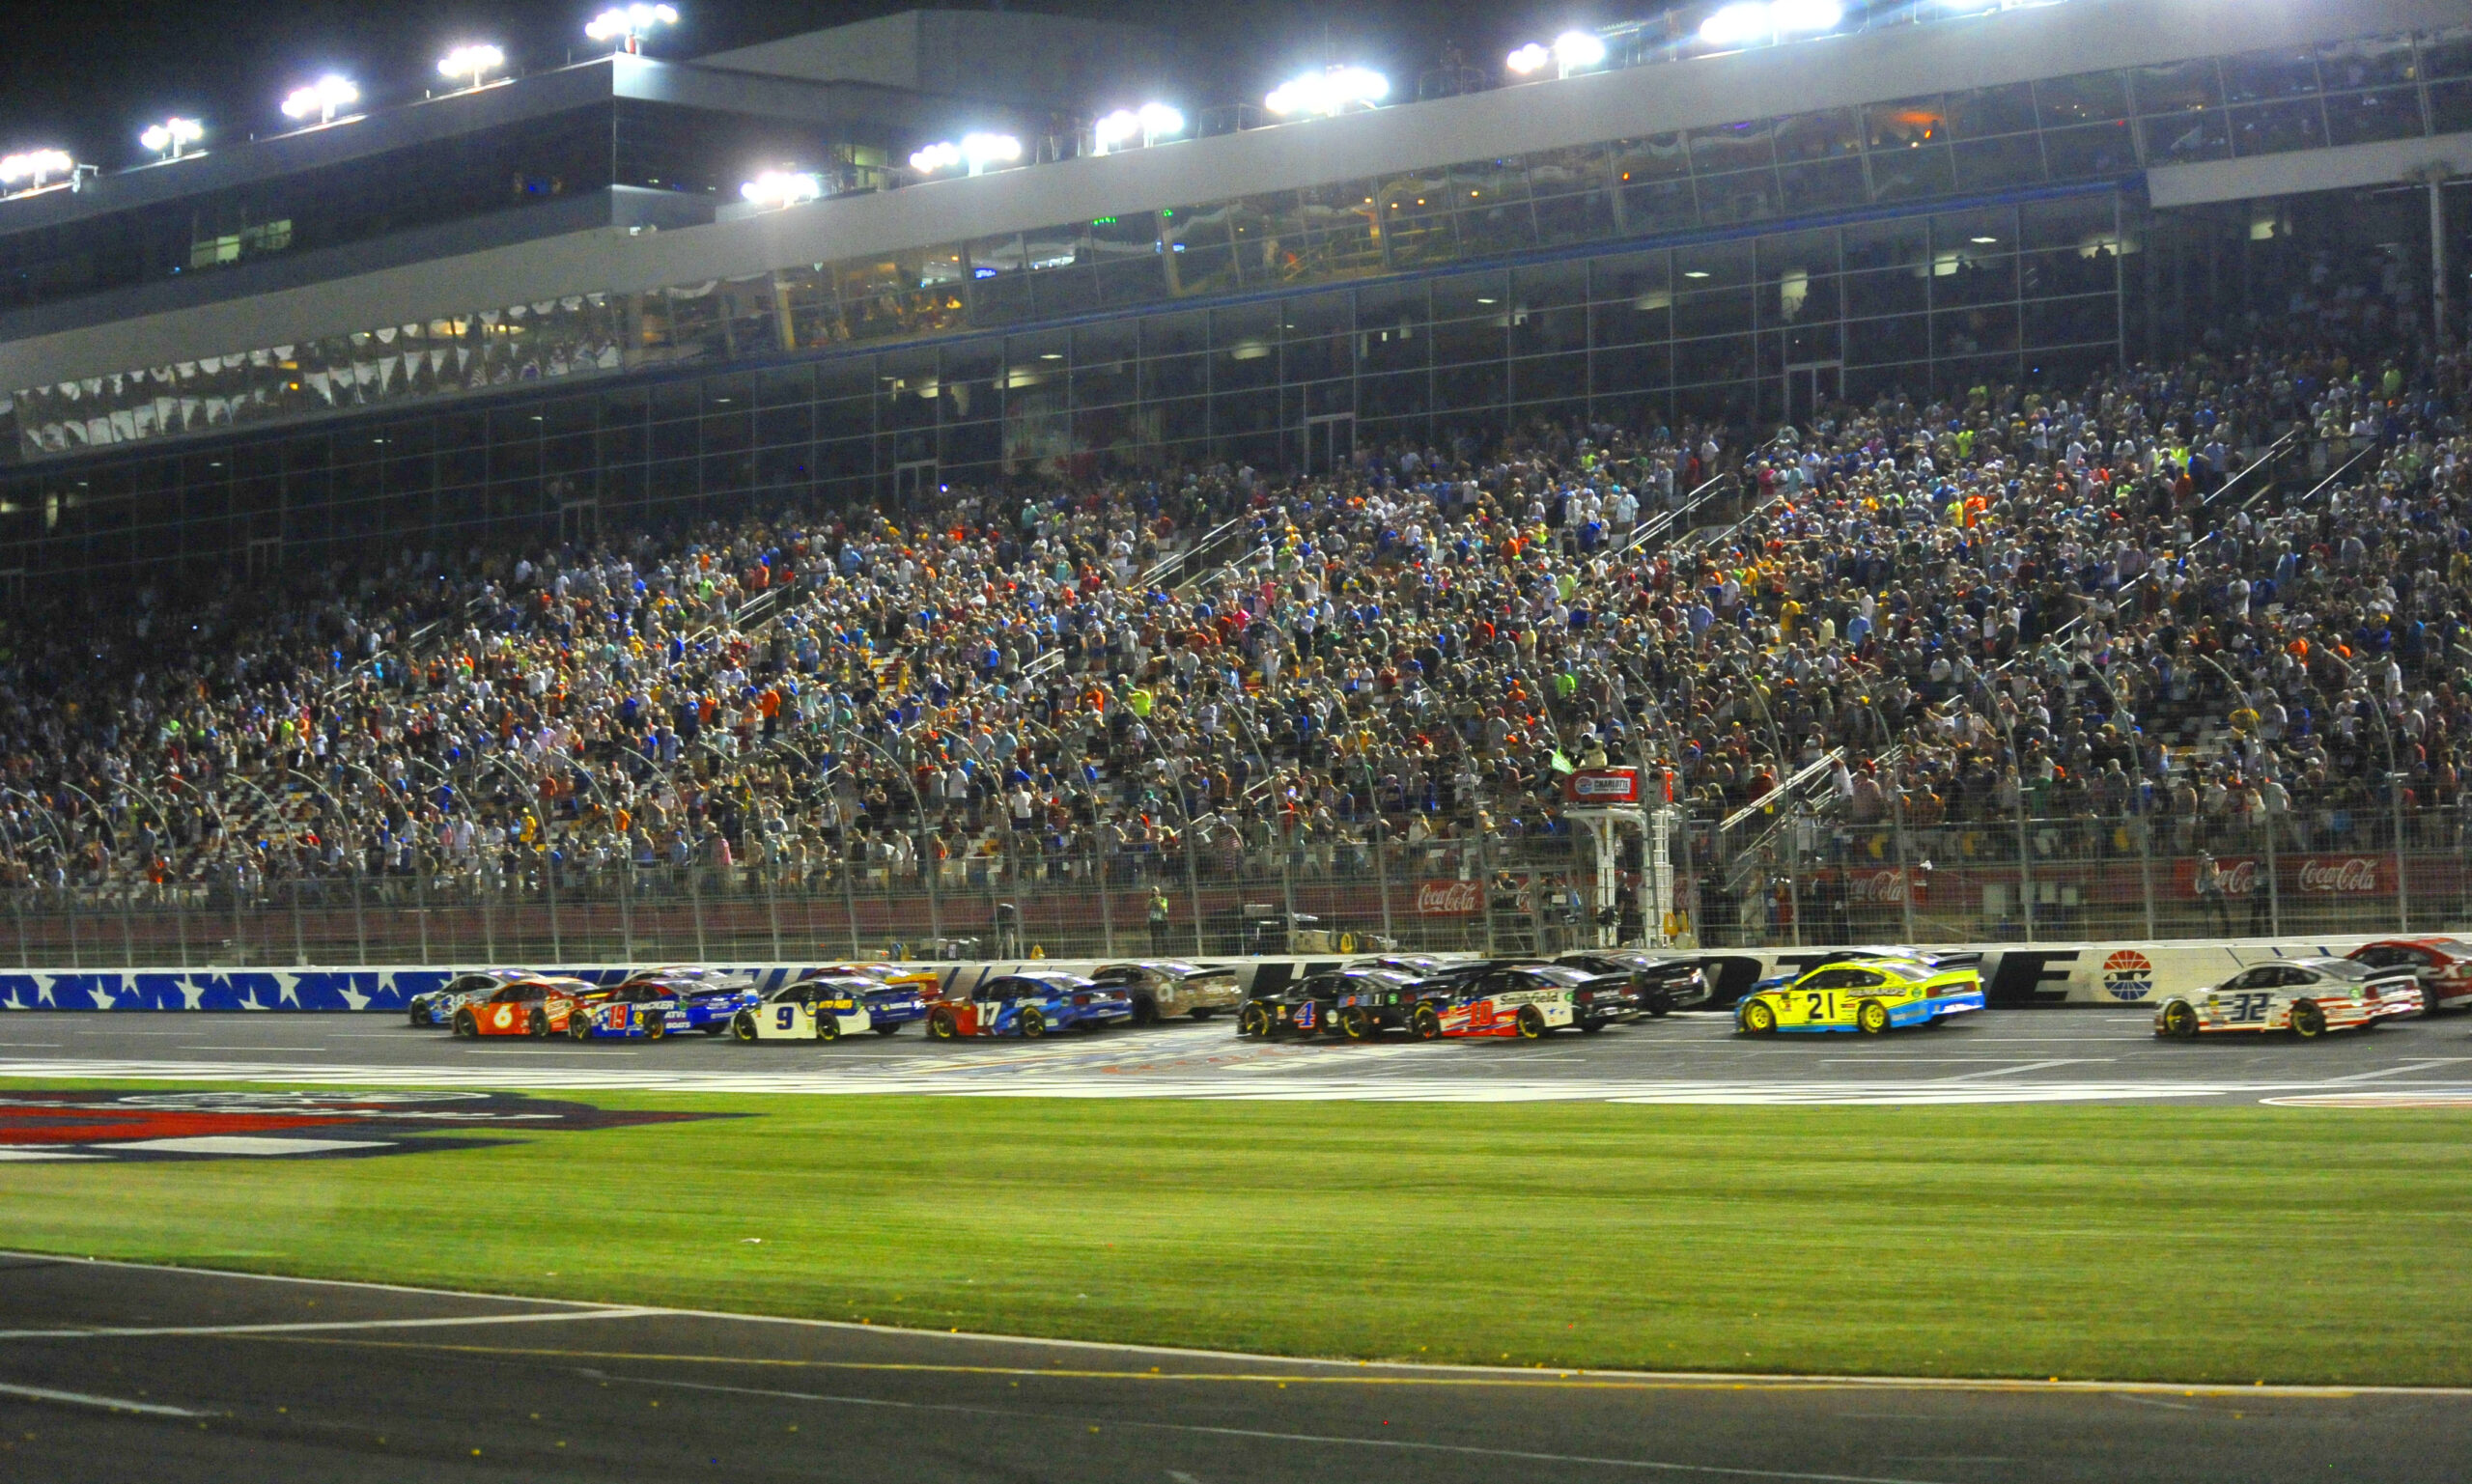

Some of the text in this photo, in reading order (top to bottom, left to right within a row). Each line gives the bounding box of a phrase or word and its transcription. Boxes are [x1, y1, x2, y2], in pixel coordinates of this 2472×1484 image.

[1500, 991, 1559, 1005] Smithfield
[1807, 993, 1836, 1020] 21
[2231, 993, 2269, 1023] 32
[493, 1002, 514, 1029] 6
[608, 1004, 629, 1030] 19
[775, 1006, 795, 1030] 9
[976, 1001, 1001, 1026] 17
[1293, 998, 1317, 1029] 4
[1467, 1000, 1494, 1027] 10
